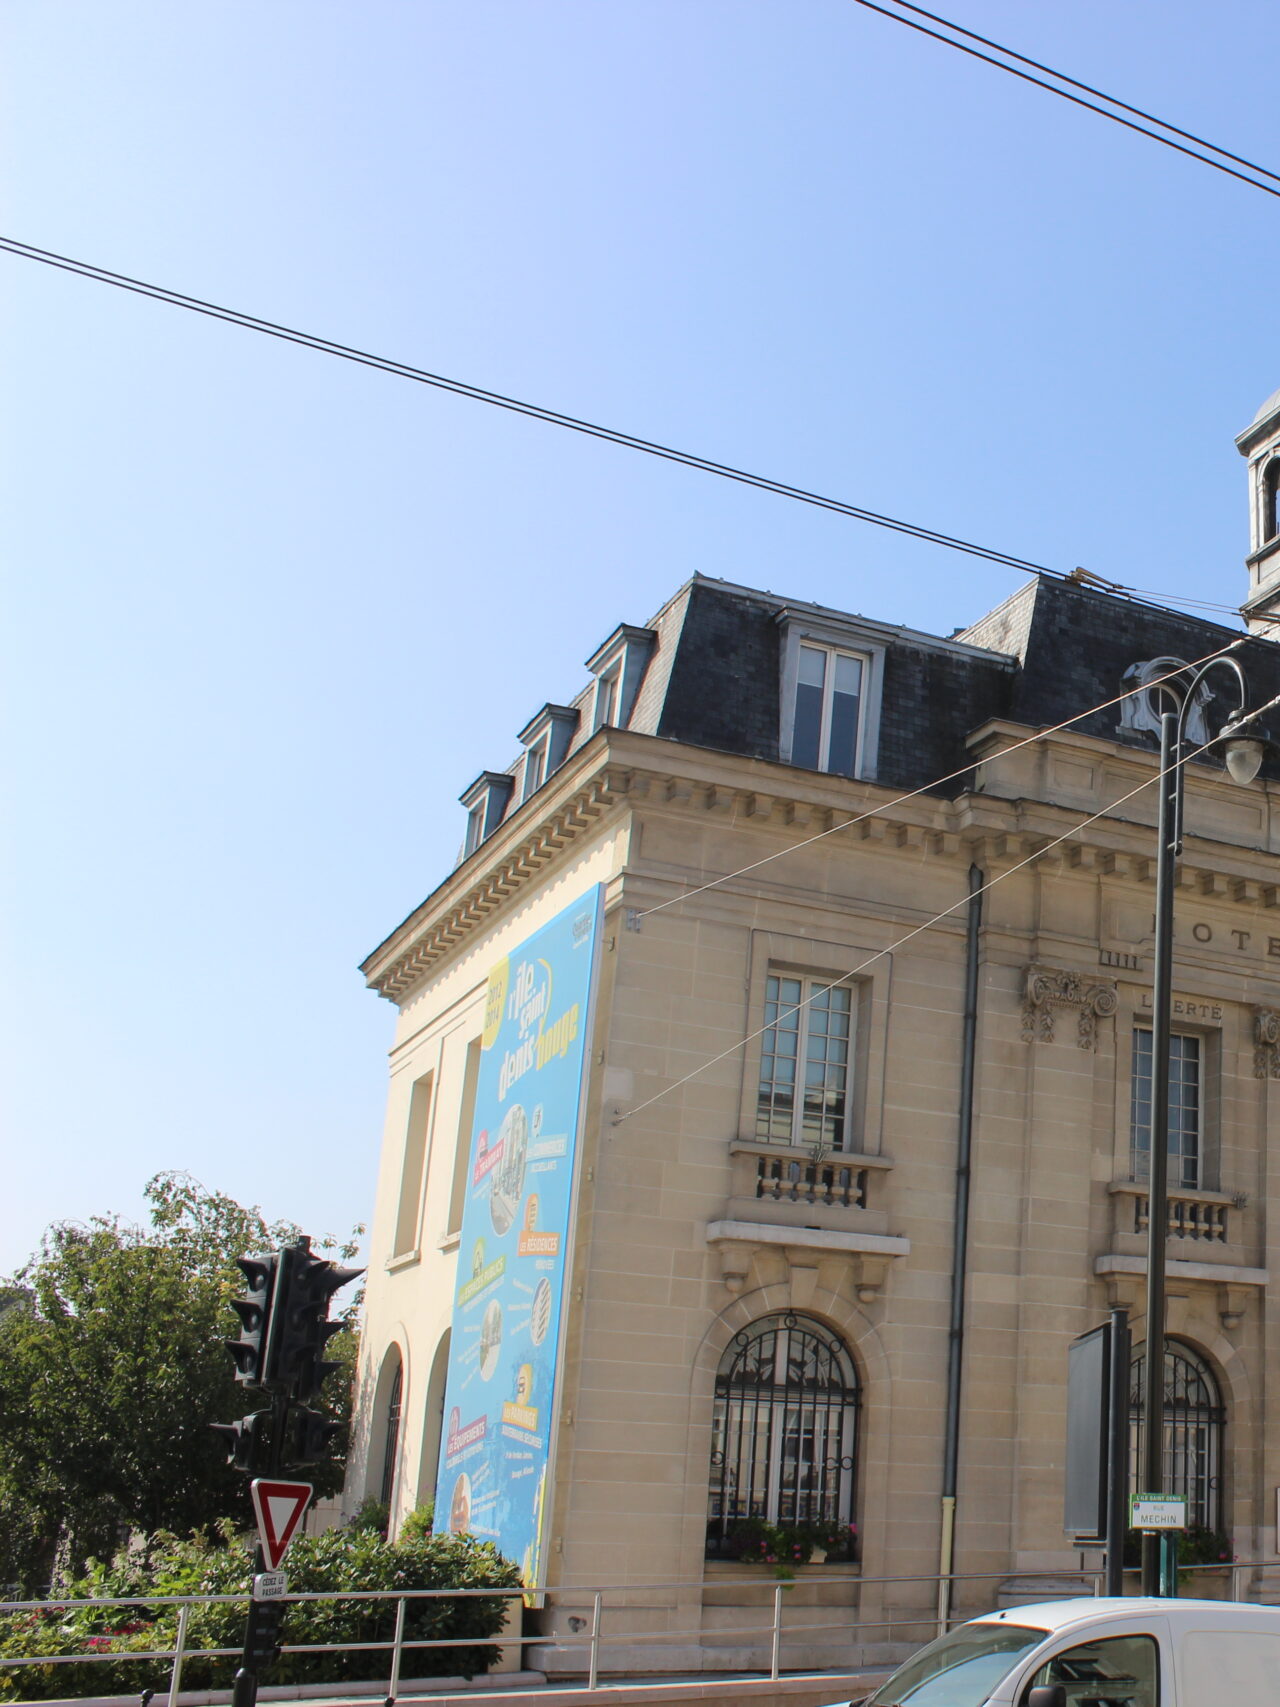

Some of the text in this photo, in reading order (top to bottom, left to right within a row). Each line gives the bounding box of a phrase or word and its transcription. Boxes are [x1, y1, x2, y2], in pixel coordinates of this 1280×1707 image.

[1141, 994, 1222, 1020] LERTÉ
[498, 1034, 535, 1103] denis
[527, 1236, 558, 1252] RÉSIDENCES
[1140, 1514, 1177, 1524] MECHIN
[278, 1576, 284, 1585] LE
[262, 1587, 282, 1596] PASSAGE
